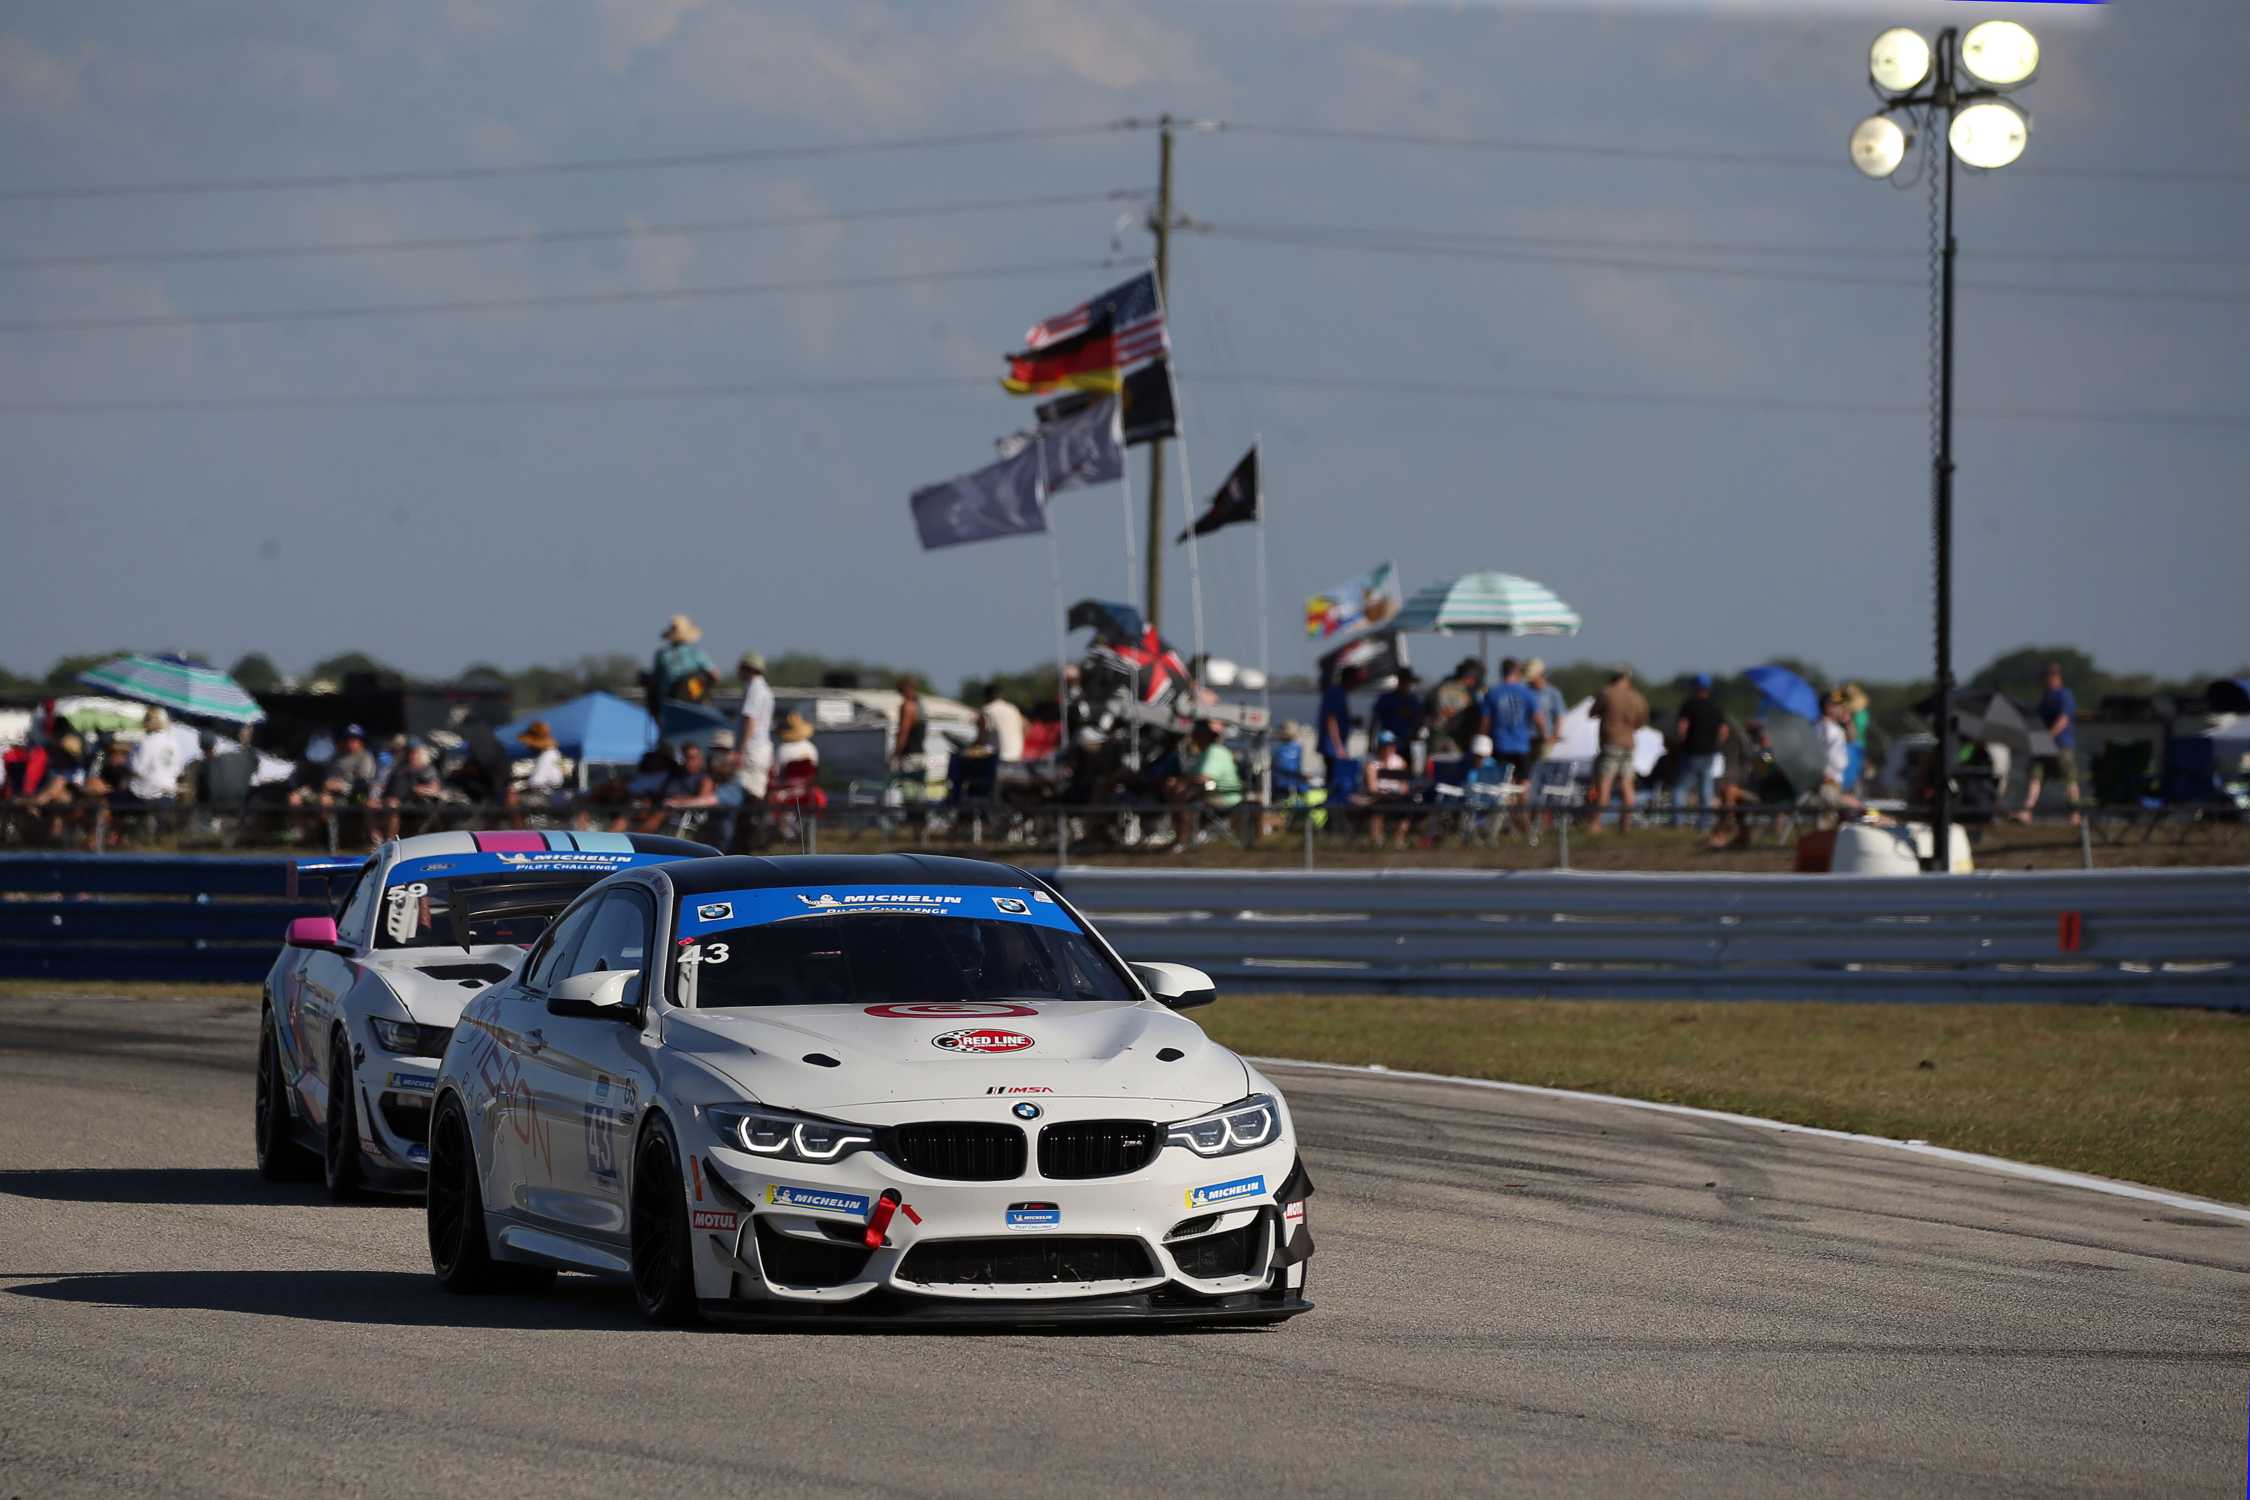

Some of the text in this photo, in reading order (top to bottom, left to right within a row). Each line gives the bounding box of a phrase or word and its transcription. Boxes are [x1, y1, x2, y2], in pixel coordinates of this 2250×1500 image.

[533, 855, 633, 863] MICHELIN
[516, 863, 619, 871] PILOT CHALLENGE
[386, 883, 428, 901] 59
[844, 895, 962, 904] MICHELIN
[677, 943, 730, 965] 43
[963, 1036, 1026, 1045] RED LINE
[1008, 1086, 1054, 1094] IMSA
[1208, 1182, 1259, 1200] MICHELIN
[794, 1194, 861, 1209] MICHELIN
[694, 1213, 736, 1228] MOTUL
